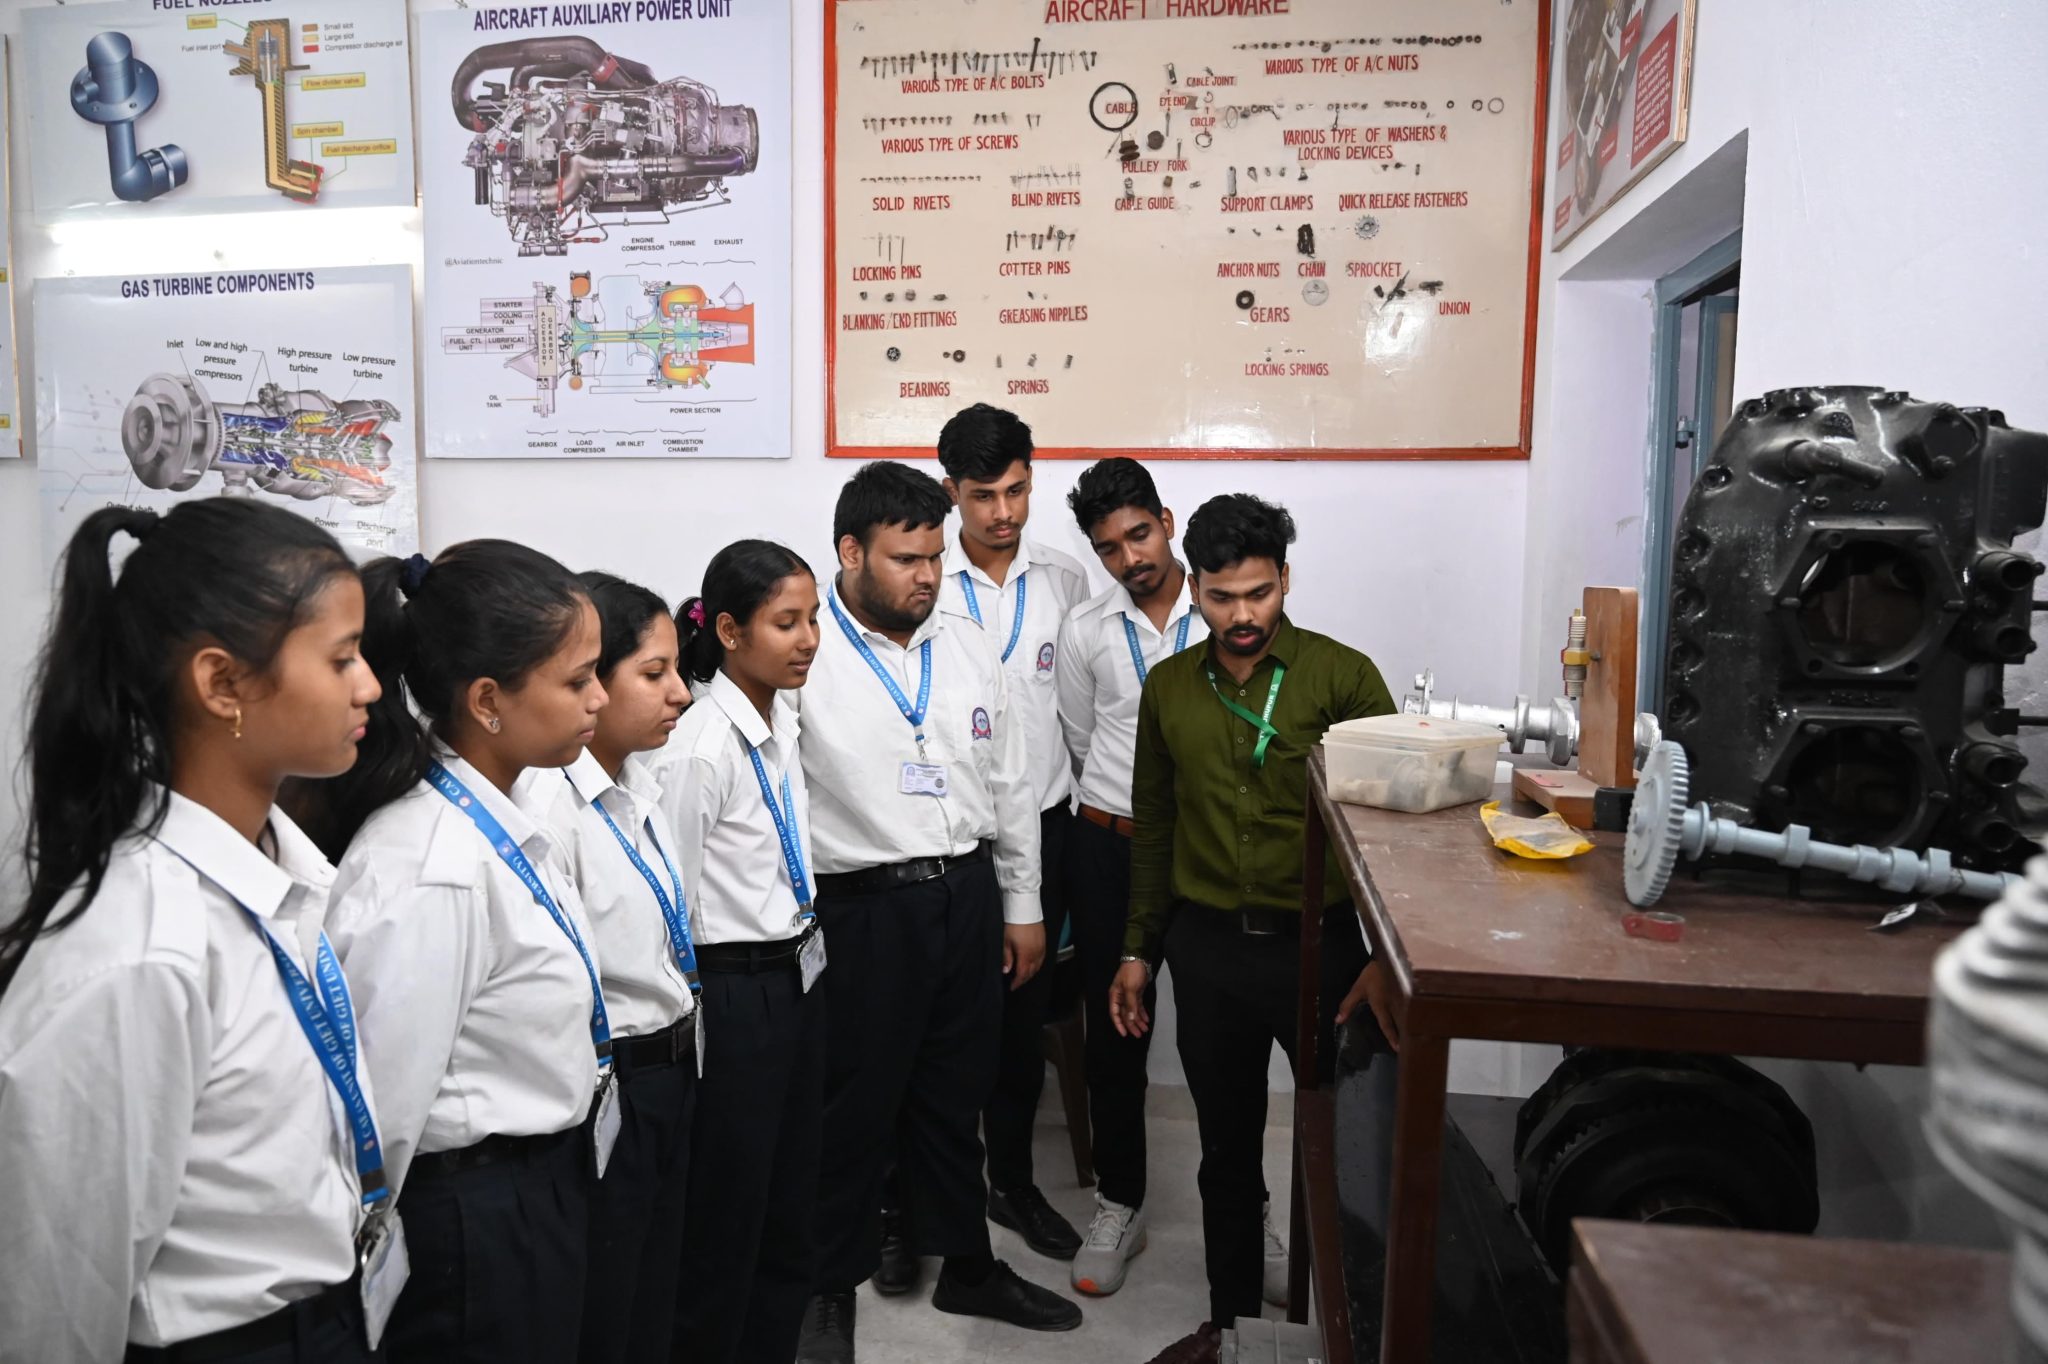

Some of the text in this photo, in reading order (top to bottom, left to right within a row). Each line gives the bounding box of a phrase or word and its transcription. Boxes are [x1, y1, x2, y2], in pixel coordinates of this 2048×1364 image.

[153, 0, 194, 10] FUEL
[474, 0, 731, 31] AIRCRAFT AUXILIARY POWER UNIT
[1265, 54, 1419, 74] VARIOUS TYPE OF A/C NUTS
[901, 74, 1044, 94] VARIOUS TYPE OF A/C BOLTS
[1187, 76, 1234, 87] CABLE JOINT
[1160, 97, 1187, 106] EYE END
[1190, 117, 1215, 127] CIRCLIP
[1283, 125, 1447, 145] VARIOUS TYPE OF WASHERS &
[882, 135, 1019, 153] VARIOUS TYPE OF SCREWS
[1298, 145, 1393, 160] LOCKING DEVICES
[1122, 160, 1188, 173] PULLEY FORK
[872, 195, 950, 211] SOLID RIVETS
[1012, 192, 1080, 207] BLIND RIVETS
[1115, 197, 1174, 210] CABLE GUIDE
[1221, 195, 1313, 212] SUPPORT CLAMPS
[1339, 191, 1468, 211] QUICK RELEASE FASTENERS
[853, 265, 921, 281] LOCKING PINS
[1000, 261, 1071, 277] COTTER PINS
[1217, 262, 1280, 277] ANCHOR NUTS
[1298, 262, 1326, 277] CHAIN
[1348, 262, 1402, 278] SPROCKET
[121, 272, 315, 298] GAS TURBINE COMPONENTS
[1000, 306, 1088, 324] GREASING NIPPLES
[1250, 307, 1290, 323] GEARS
[1439, 302, 1470, 316] UNION
[914, 311, 957, 327] FITTINGS
[167, 340, 184, 348] Inlet
[196, 338, 248, 353] Low and high
[204, 355, 236, 365] pressure
[278, 347, 332, 360] High pressure
[343, 352, 396, 366] Low pressure
[195, 368, 243, 381] compressors
[289, 363, 318, 373] turbine
[353, 369, 383, 379] turbine
[1245, 363, 1329, 376] LOCKING SPRINGS
[900, 381, 950, 397] BEARINGS
[1007, 379, 1049, 395] SPRINGS
[865, 653, 879, 670] GIET
[876, 667, 885, 677] OF
[436, 774, 462, 797] CAE
[751, 753, 774, 804] UNIVERSITY)
[769, 804, 782, 823] GIET
[785, 803, 793, 819] GIET
[777, 824, 785, 835] OF
[788, 821, 795, 830] OF
[780, 835, 792, 854] UNIT
[787, 862, 800, 880] CAE
[645, 869, 660, 891] GIET
[657, 891, 666, 903] OF
[662, 902, 674, 923] UNIT
[671, 931, 684, 950] CAE
[329, 982, 351, 1040] OF GIET
[314, 1017, 339, 1053] GIET
[331, 1051, 348, 1071] OF
[341, 1070, 361, 1101] UNIT
[356, 1112, 373, 1138] CAE
